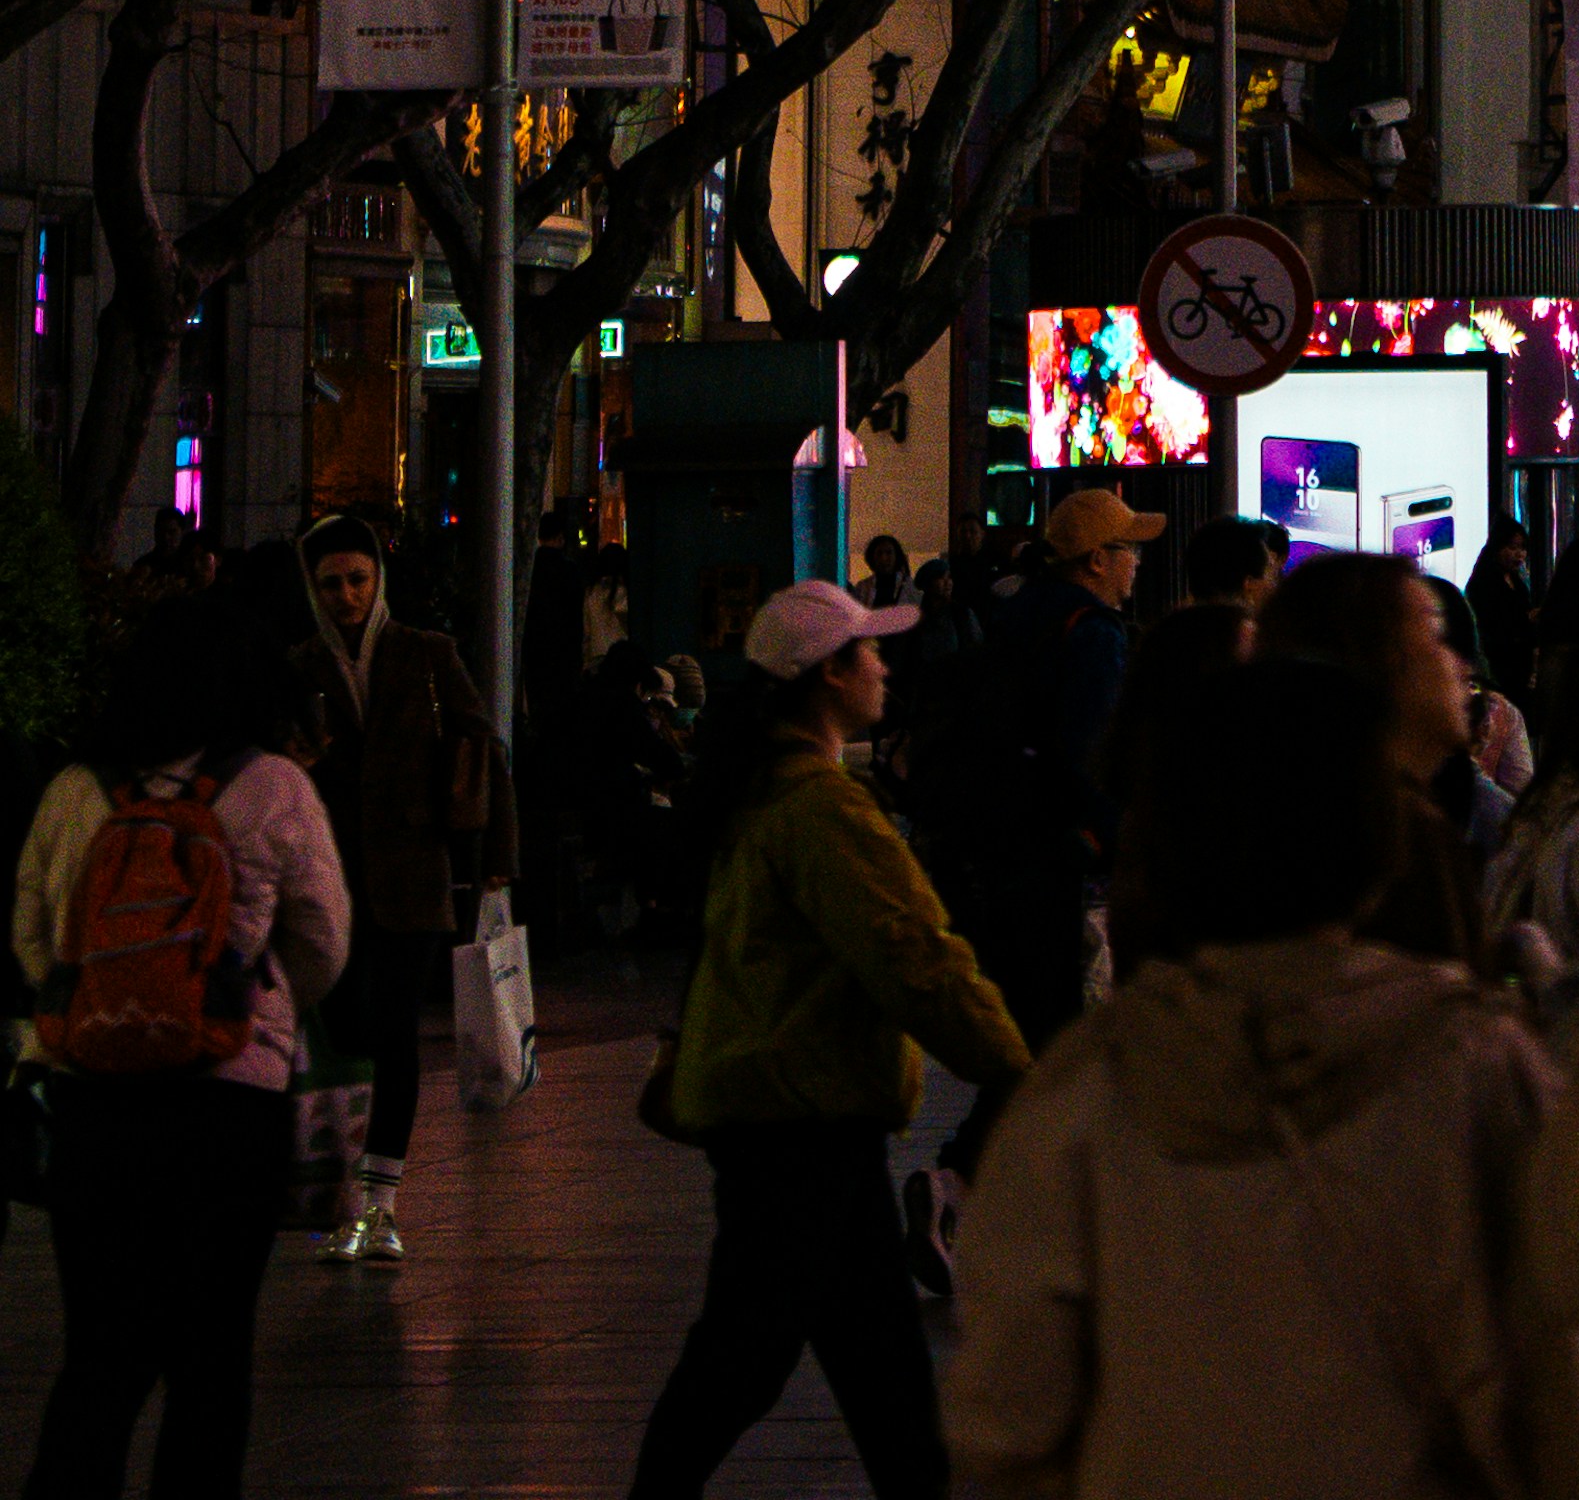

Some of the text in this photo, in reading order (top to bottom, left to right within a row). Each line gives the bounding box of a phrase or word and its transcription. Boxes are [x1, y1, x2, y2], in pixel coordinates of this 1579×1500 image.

[1295, 464, 1320, 489] 16
[1295, 489, 1320, 510] 10
[1417, 538, 1433, 555] 16
